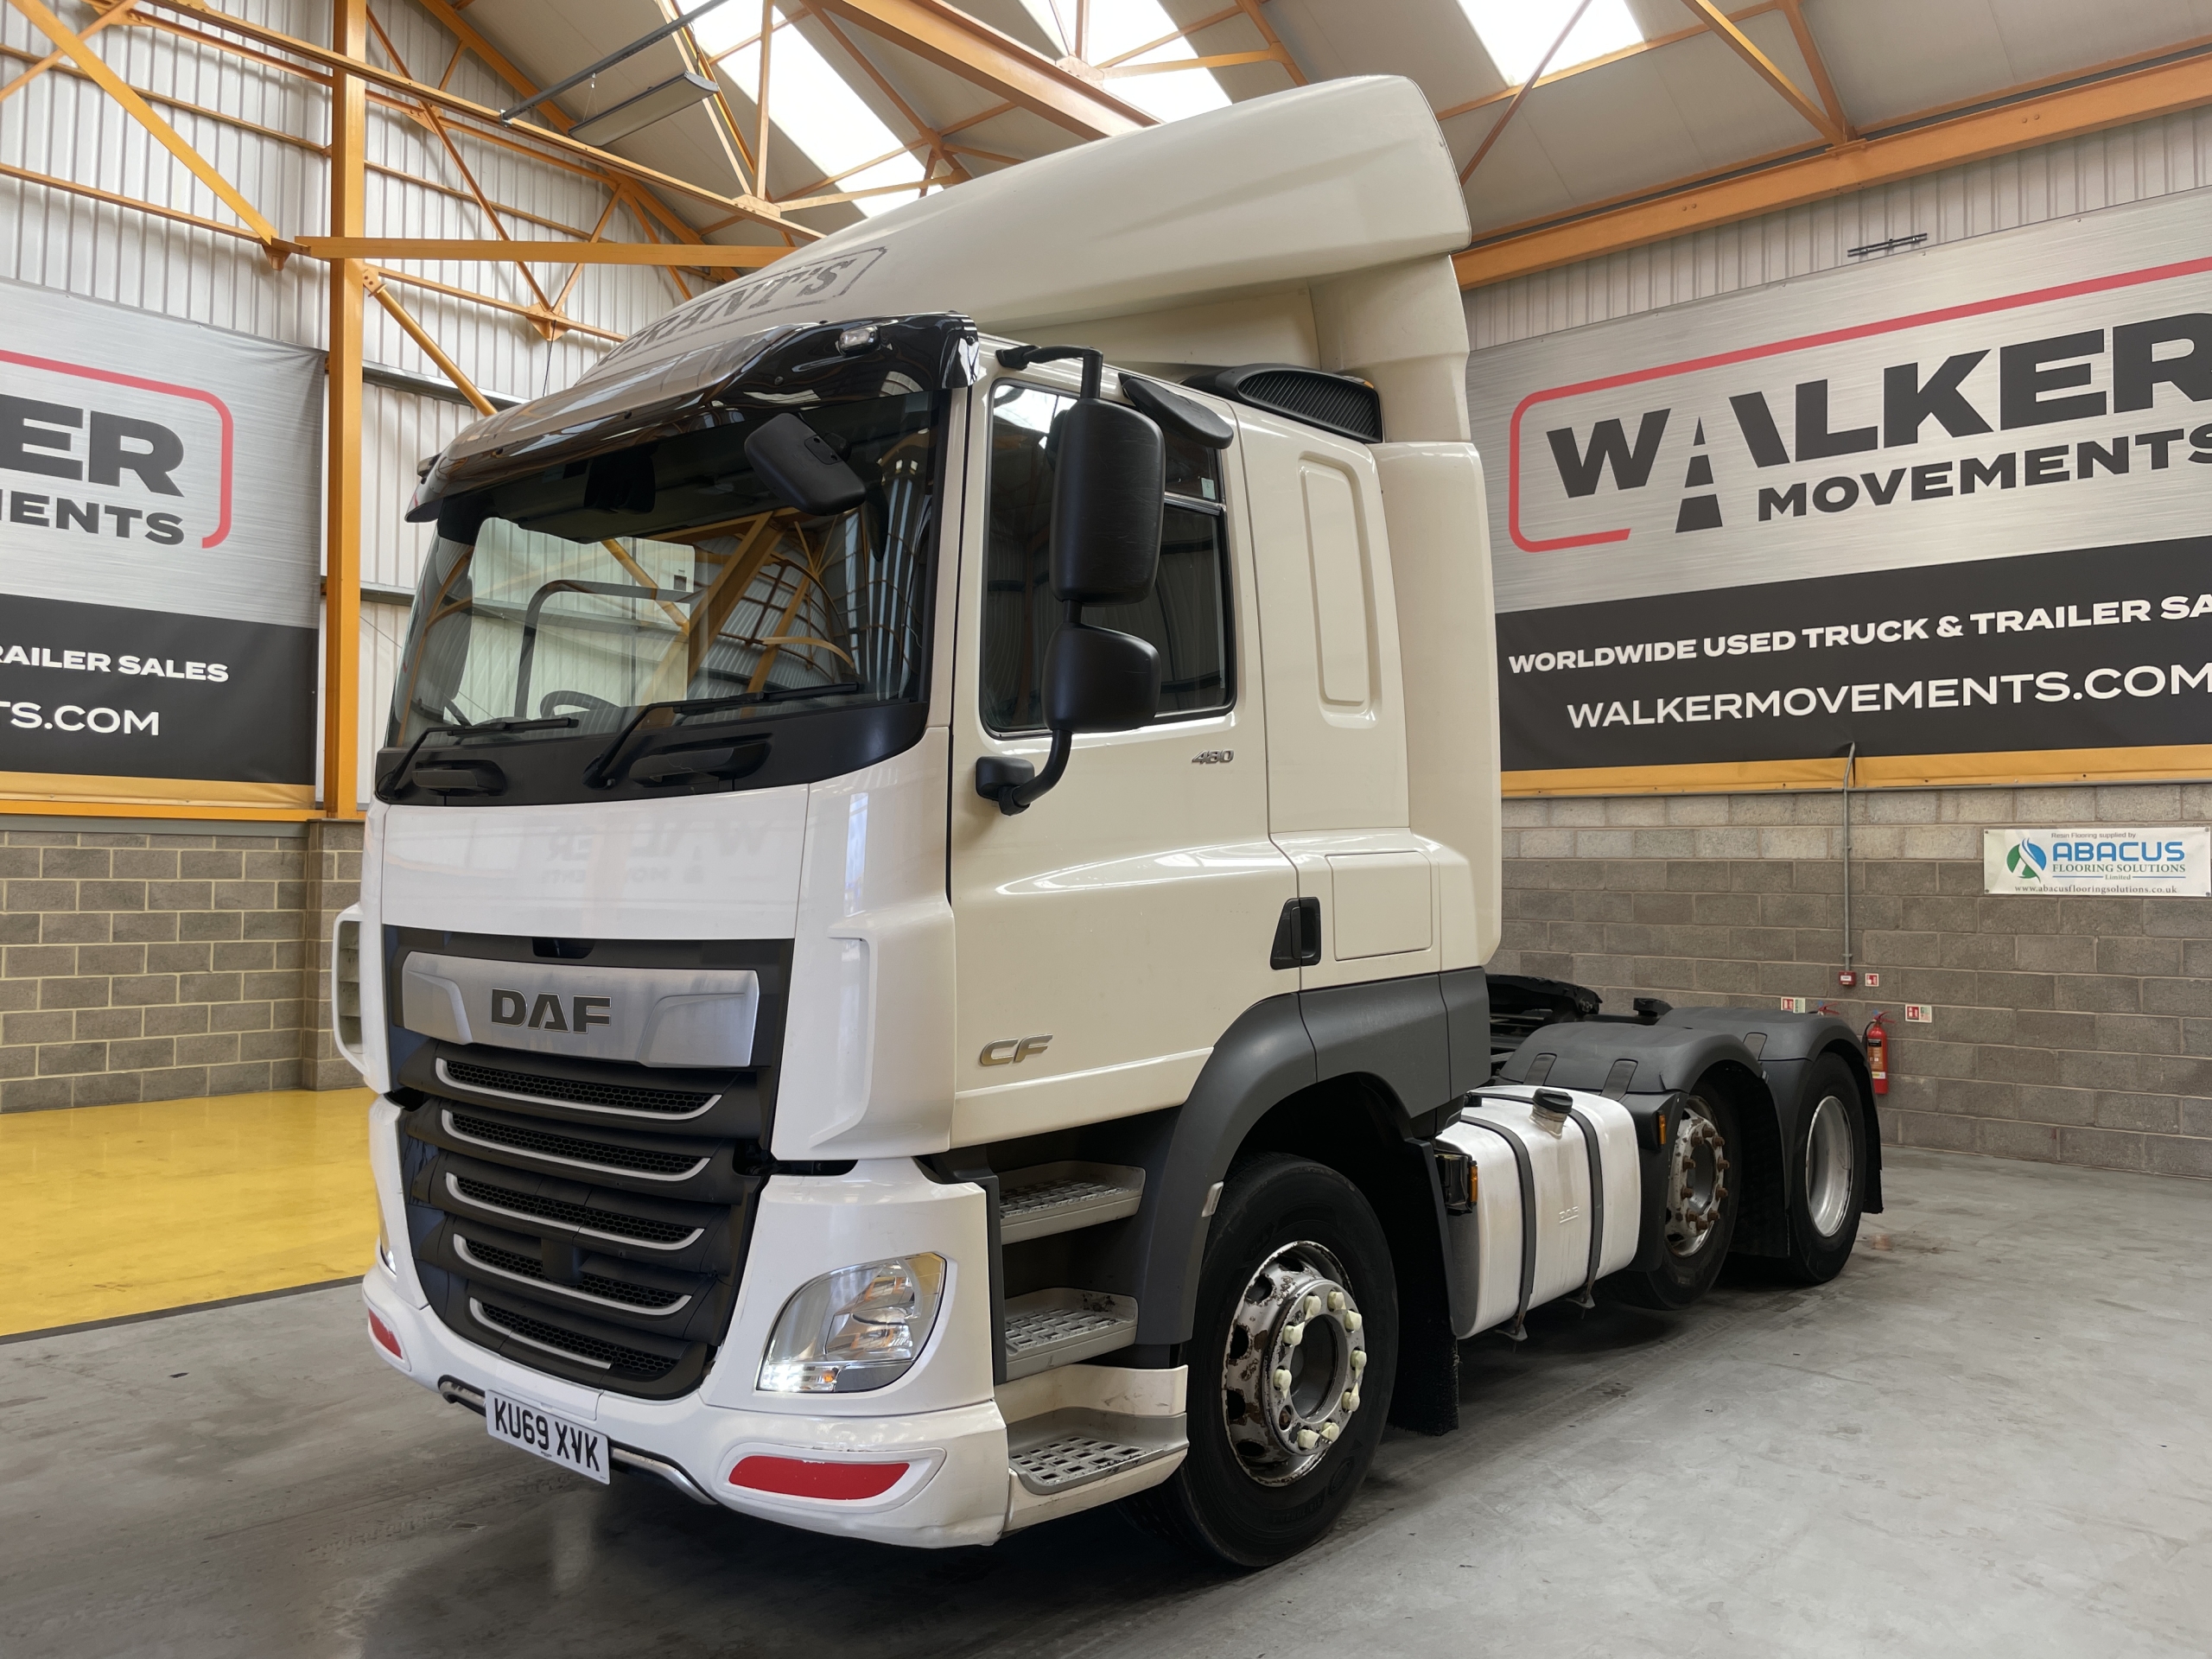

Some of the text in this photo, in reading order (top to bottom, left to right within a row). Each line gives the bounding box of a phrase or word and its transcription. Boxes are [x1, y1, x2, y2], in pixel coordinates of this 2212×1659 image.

[1547, 313, 2212, 533] WALKER
[0, 489, 184, 545] ENTS
[1509, 639, 1697, 673] WORLDWIDE
[1704, 630, 1796, 657] USED
[1802, 618, 1929, 648] TRUCK
[1936, 615, 1963, 637] &
[1971, 599, 2152, 635] TRAILER
[0, 644, 229, 682] AILER SALES
[1567, 662, 2212, 729] WALKERMOVEMENTS.COM
[1192, 749, 1234, 764] 480
[2052, 842, 2185, 861] ABACUS
[2052, 864, 2186, 873] FLOORING SOLUTIONS
[2014, 885, 2177, 895] www.abacusflooringsolutions.co.uk
[491, 988, 612, 1034] DAF
[979, 1033, 1052, 1066] CF
[494, 1397, 601, 1471] KU69 XVK
